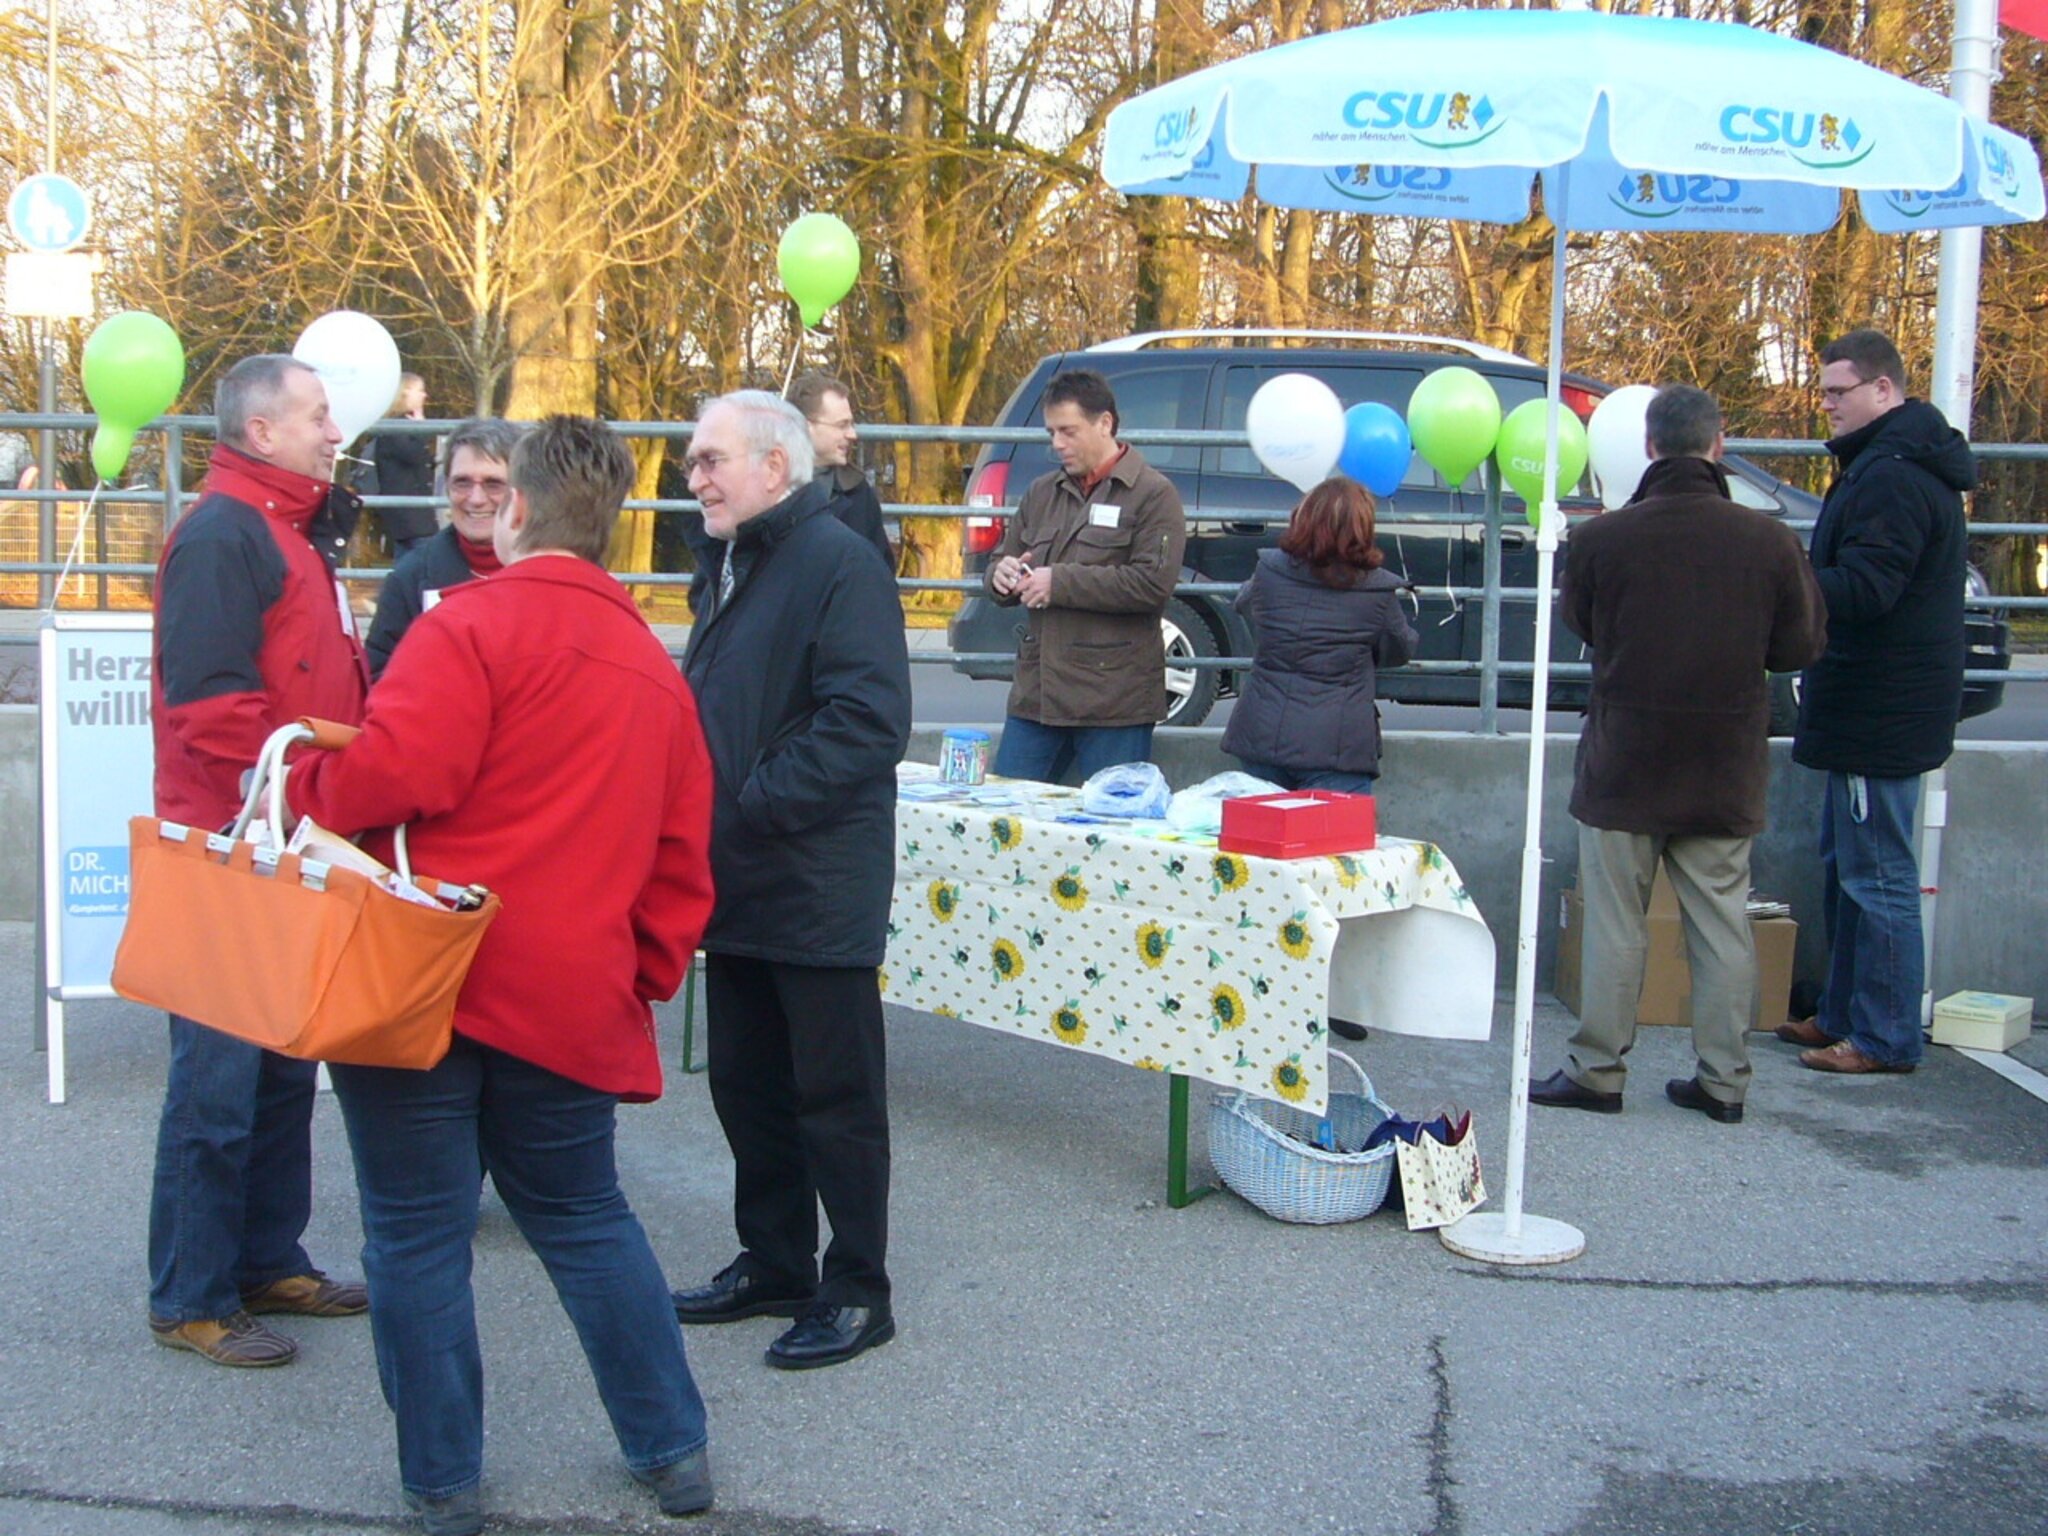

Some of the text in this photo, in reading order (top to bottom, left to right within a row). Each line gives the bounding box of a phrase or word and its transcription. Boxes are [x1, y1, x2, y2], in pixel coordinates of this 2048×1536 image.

[1342, 91, 1446, 129] CSU
[1719, 104, 1815, 148] CSU
[1312, 131, 1339, 142] näher
[1340, 132, 1357, 141] am
[1720, 147, 1735, 155] am
[1511, 456, 1544, 474] CSU
[67, 647, 151, 682] Herz
[70, 852, 106, 871] DR.
[70, 875, 129, 895] MICH
